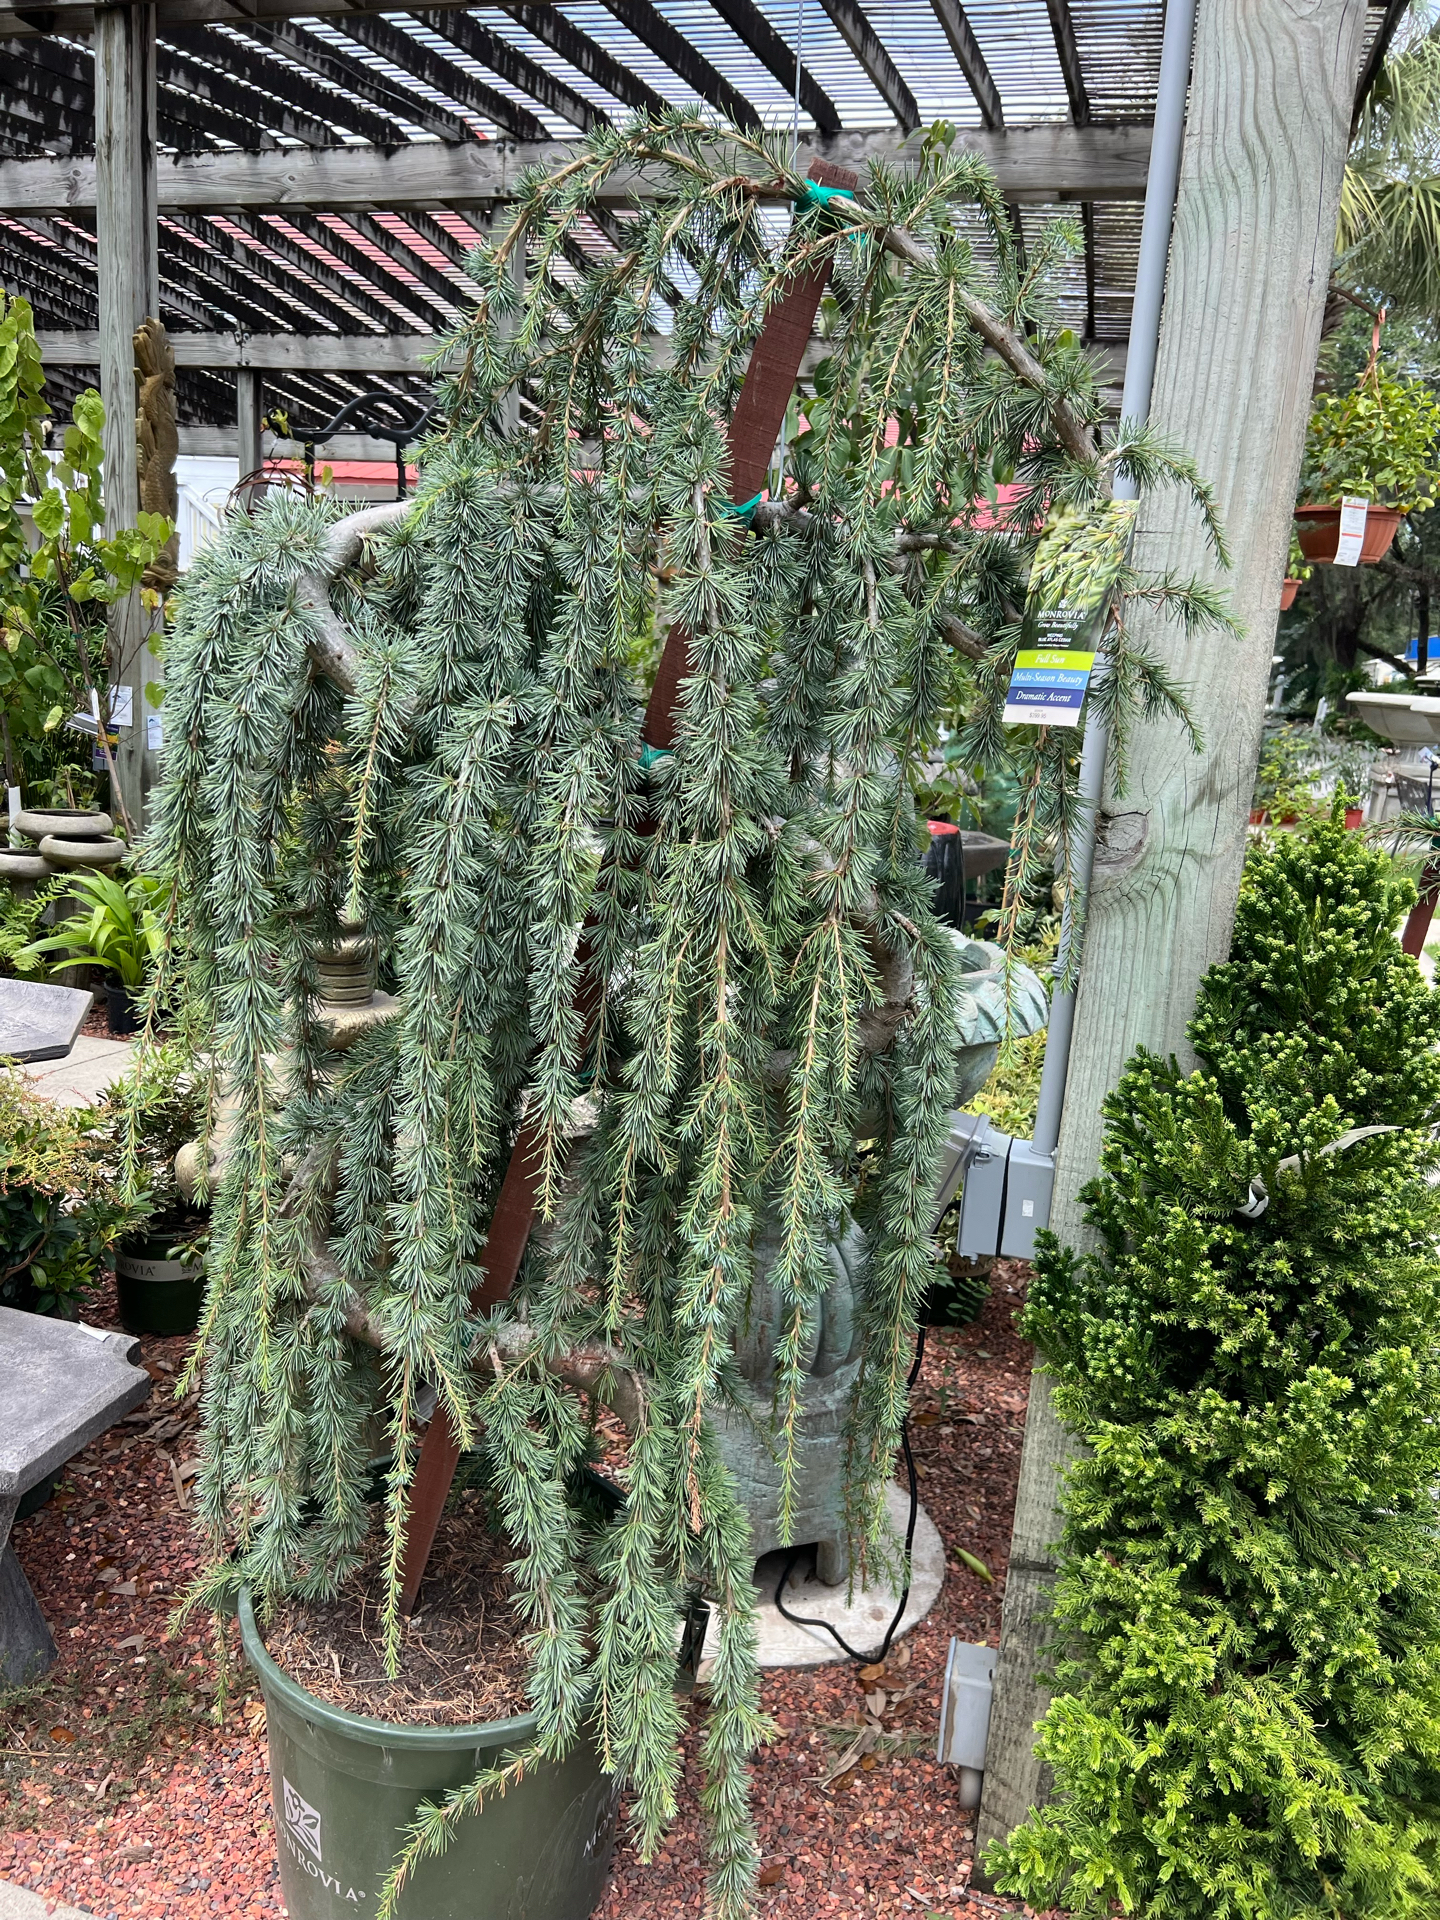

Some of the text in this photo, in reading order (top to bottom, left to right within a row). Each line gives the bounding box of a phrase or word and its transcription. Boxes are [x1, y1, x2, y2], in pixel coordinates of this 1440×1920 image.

[1051, 621, 1079, 630] Beautifully
[1035, 653, 1065, 664] Full Sun
[1014, 672, 1083, 686] Multi-Season Beauty
[1016, 690, 1072, 702] Dramatic Accent
